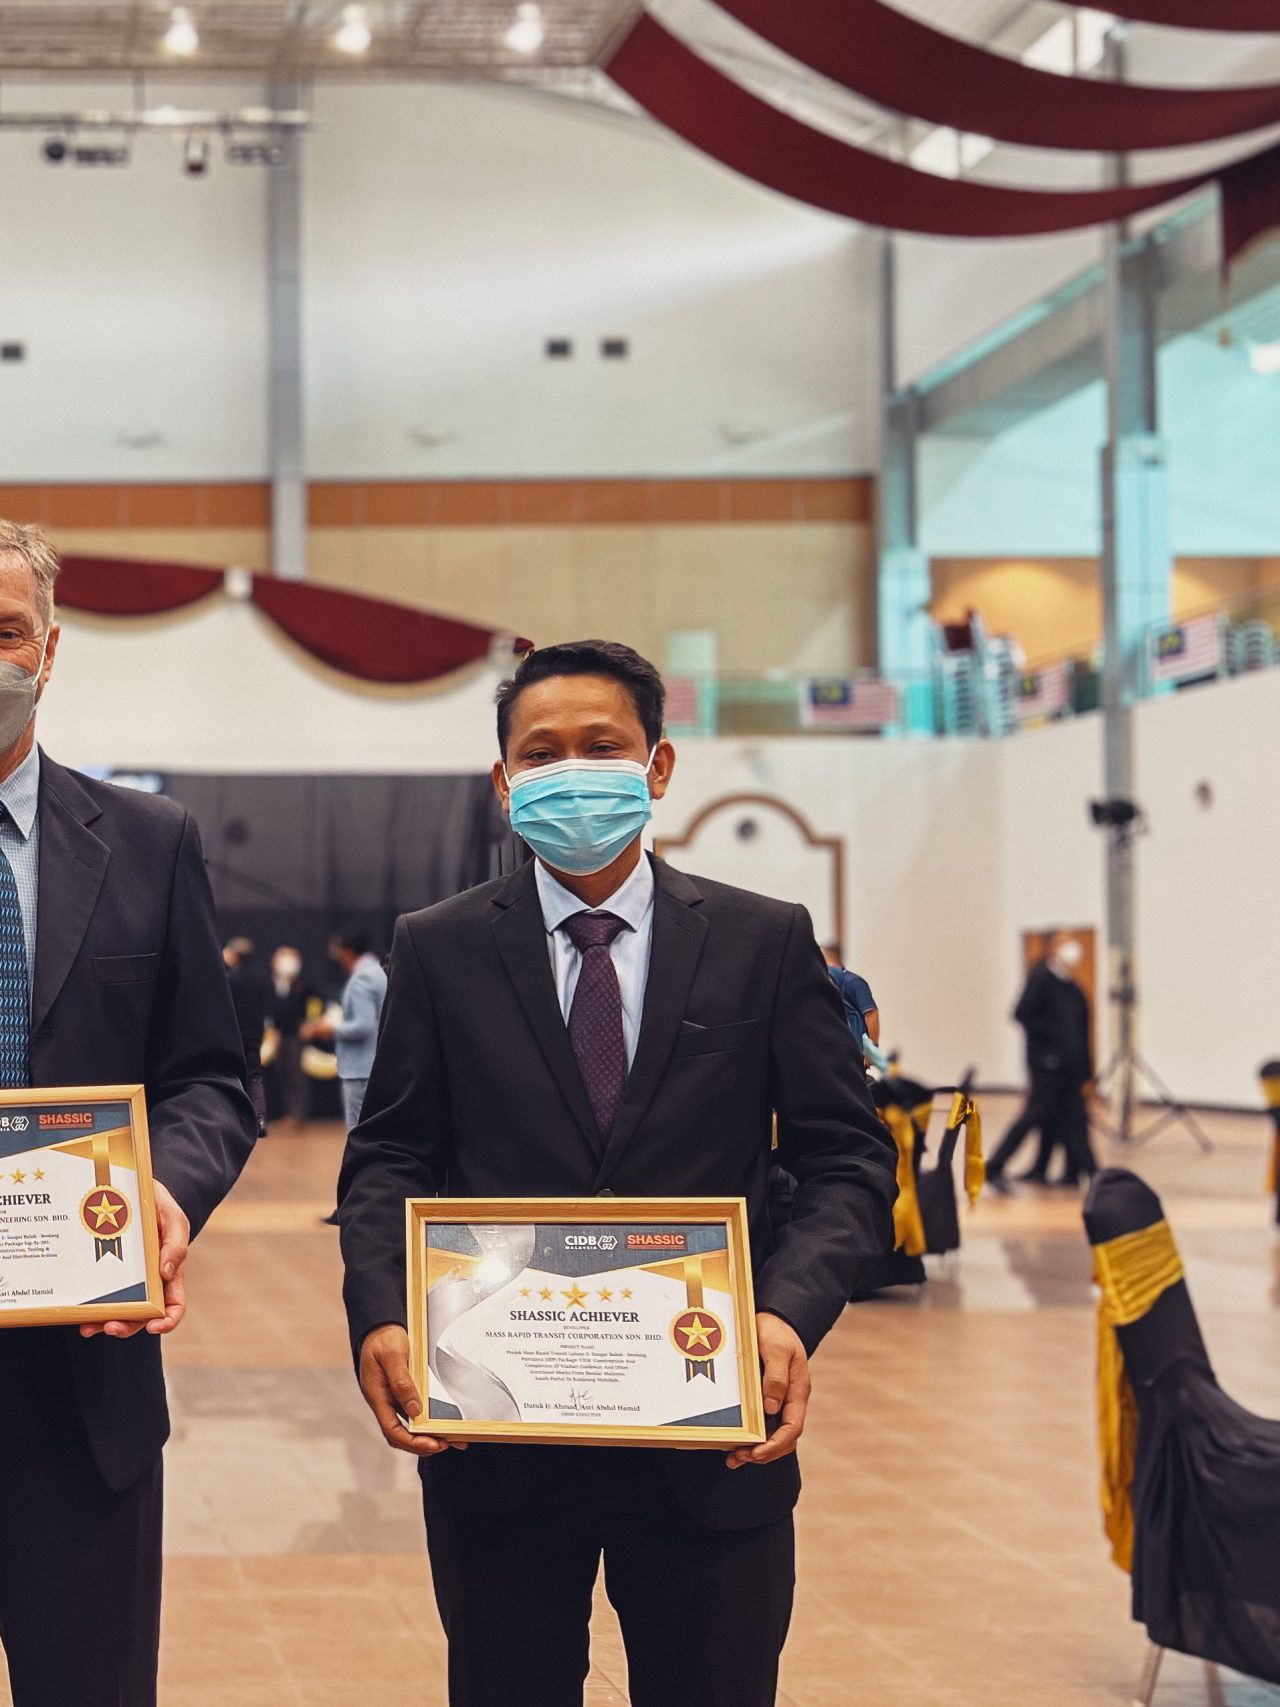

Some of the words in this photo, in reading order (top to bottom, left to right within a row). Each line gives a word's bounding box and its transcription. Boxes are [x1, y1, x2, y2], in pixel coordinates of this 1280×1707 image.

[39, 1113, 92, 1125] SHASSIC
[564, 1235, 597, 1246] CIDB
[627, 1235, 685, 1245] SHASSIC
[509, 1310, 566, 1322] SHASSIC
[569, 1311, 640, 1323] ACHIEVER
[567, 1332, 623, 1340] CORPORATION
